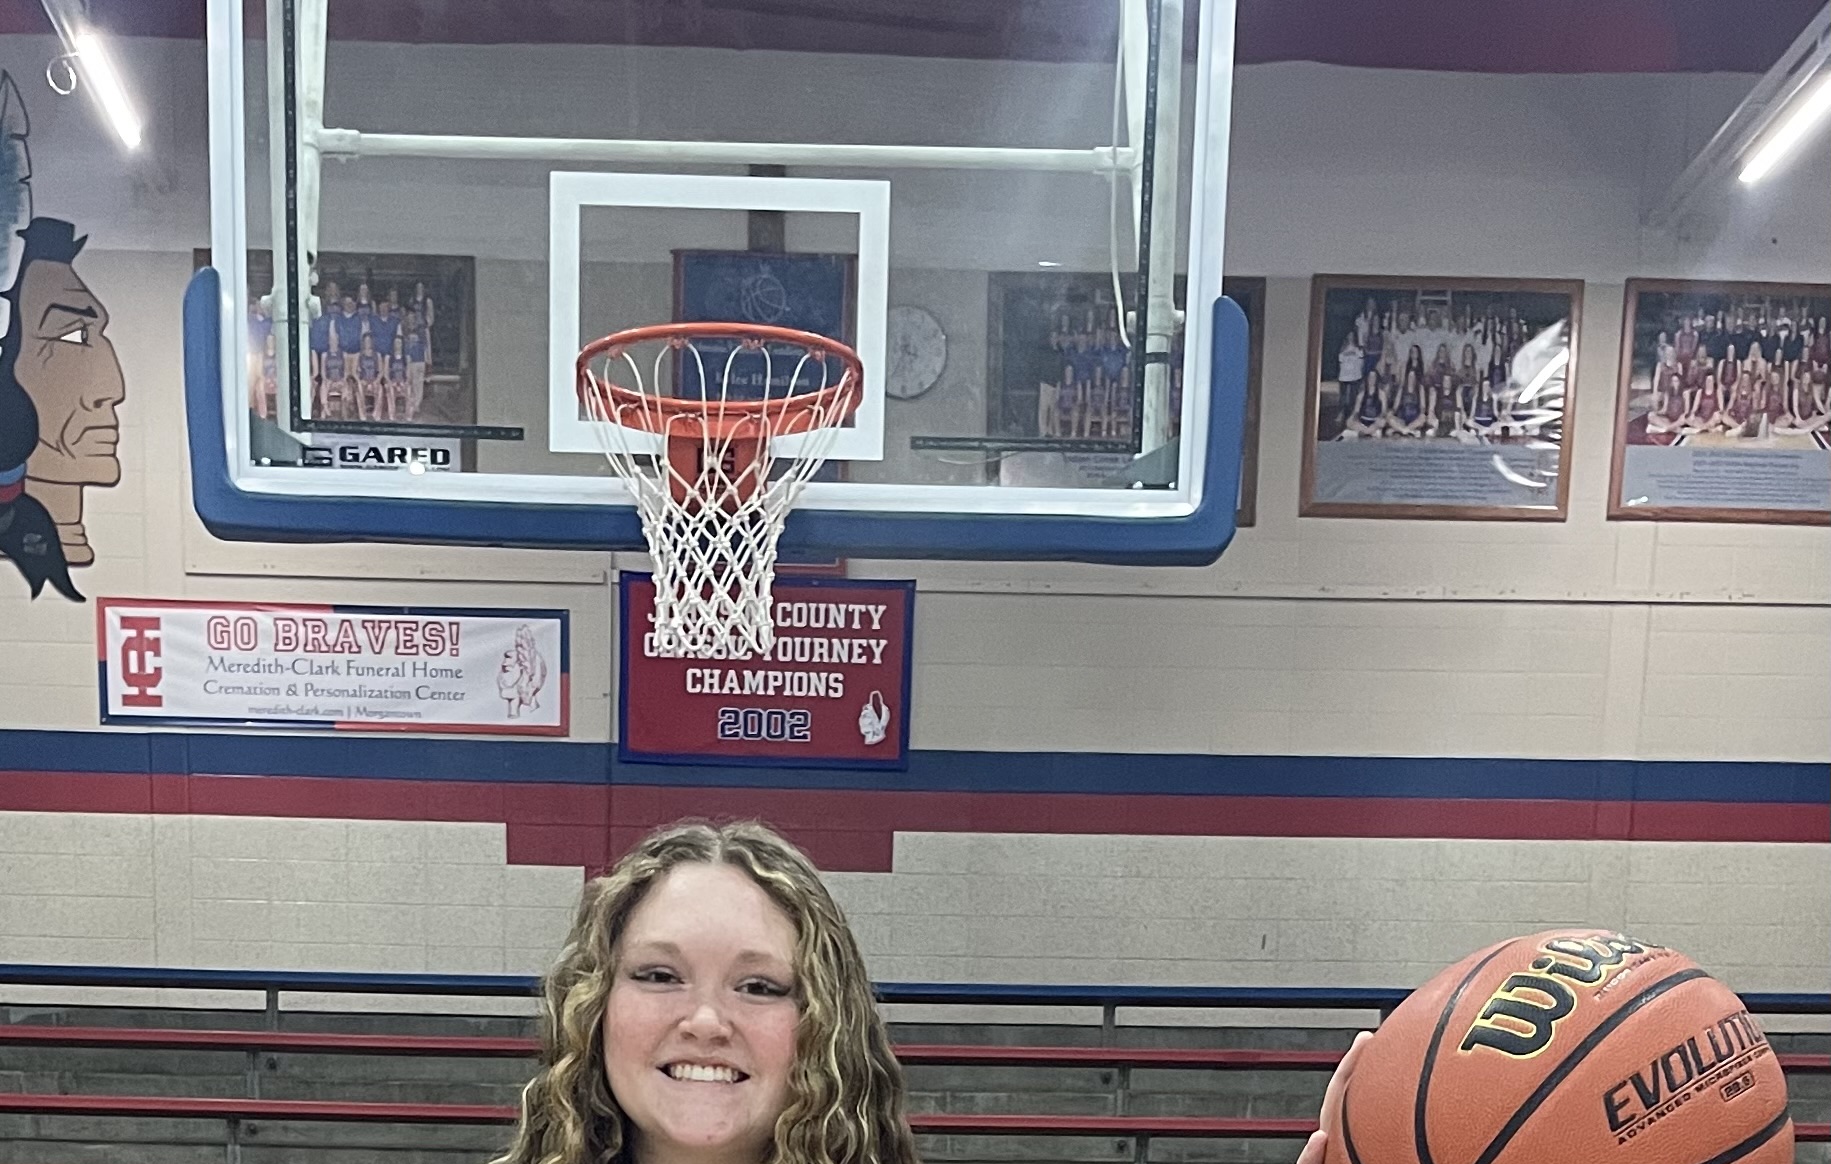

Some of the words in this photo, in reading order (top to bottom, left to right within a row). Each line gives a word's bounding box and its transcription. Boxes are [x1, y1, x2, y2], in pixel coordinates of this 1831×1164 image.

[339, 446, 450, 465] GARED
[776, 602, 887, 630] COUNTY
[207, 616, 258, 651] GO
[274, 618, 460, 656] BRAVES!
[206, 656, 341, 676] Meredith-Clark
[347, 659, 405, 678] Funeral
[412, 661, 463, 680] Home
[203, 680, 281, 697] Cremation
[286, 682, 298, 697] &
[304, 683, 411, 701] Personalization
[415, 685, 466, 702] Center
[686, 668, 844, 698] CHAMPIONS
[718, 707, 811, 742] 2002
[1618, 1093, 1692, 1146] ADVANCED
